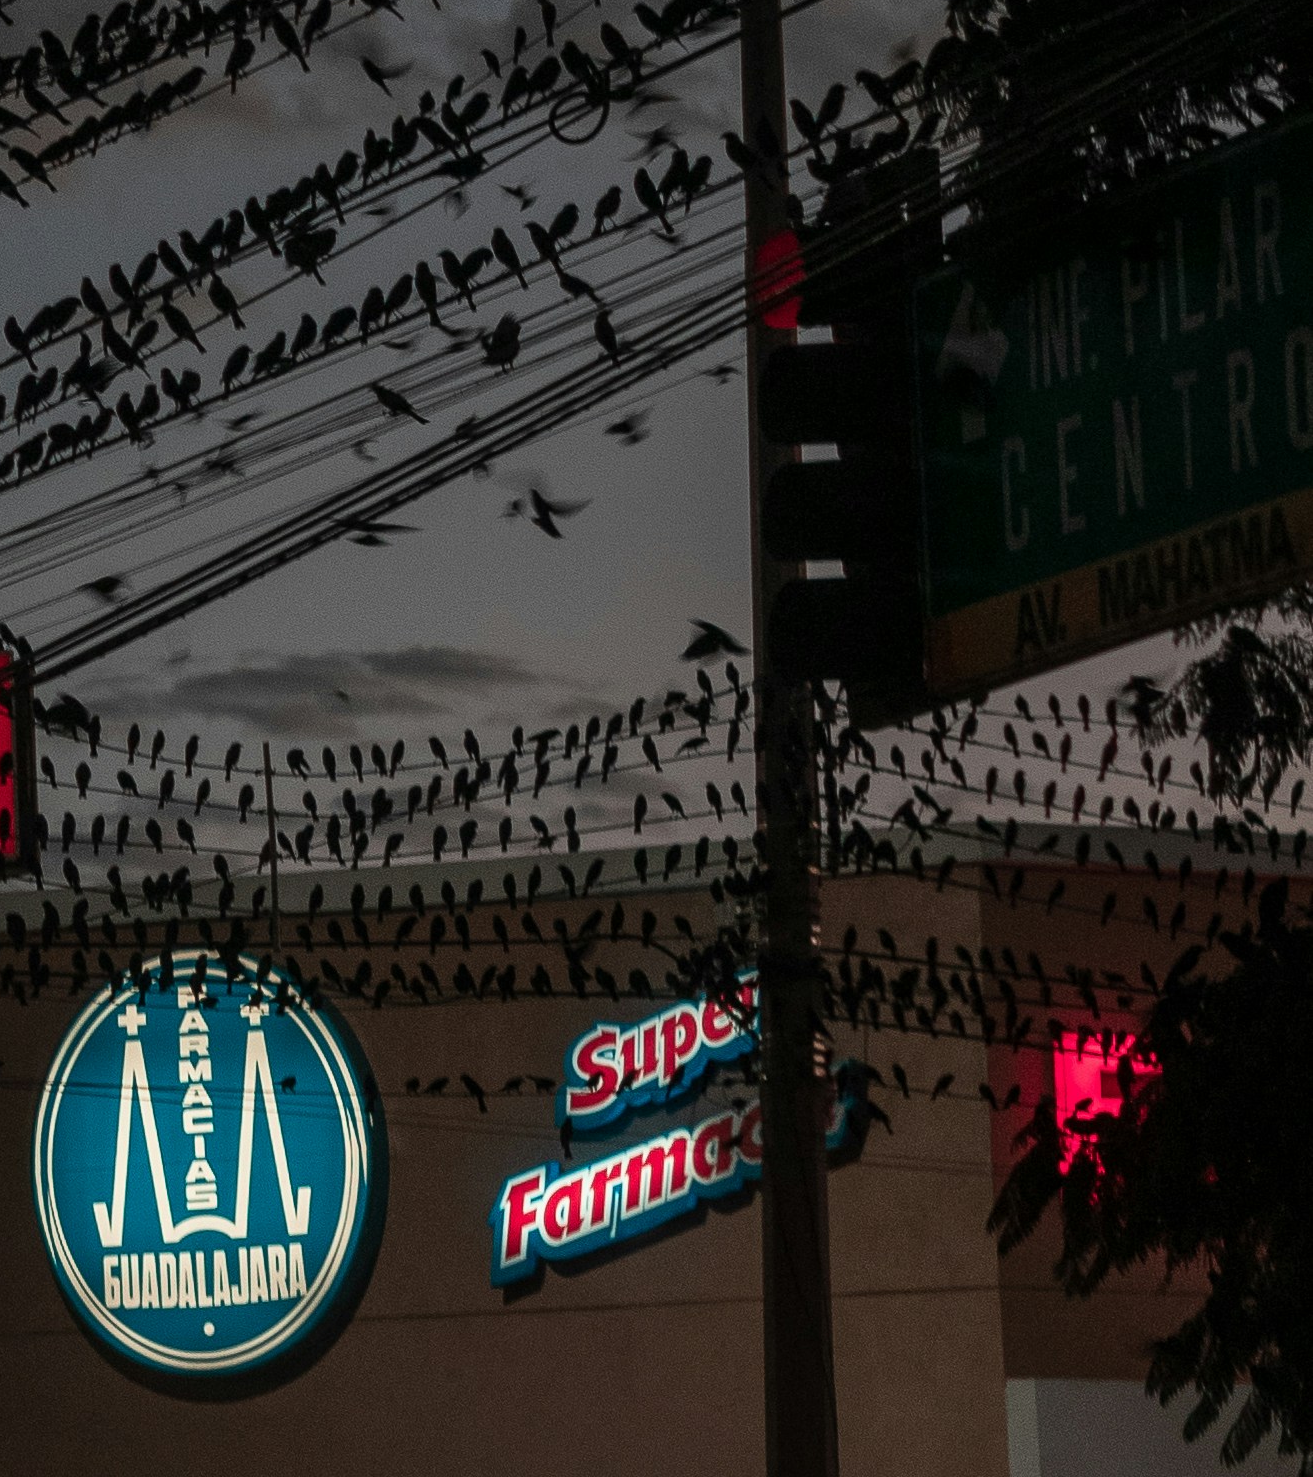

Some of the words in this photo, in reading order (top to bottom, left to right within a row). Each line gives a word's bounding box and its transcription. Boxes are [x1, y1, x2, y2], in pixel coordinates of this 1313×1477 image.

[1118, 181, 1285, 357] PILAR
[1001, 325, 1313, 552] CENTRO
[1014, 582, 1068, 664] AV.
[1096, 504, 1298, 627] MAHATMA
[177, 985, 219, 1211] FARMACIAS
[102, 1242, 309, 1310] GUADALAJARA
